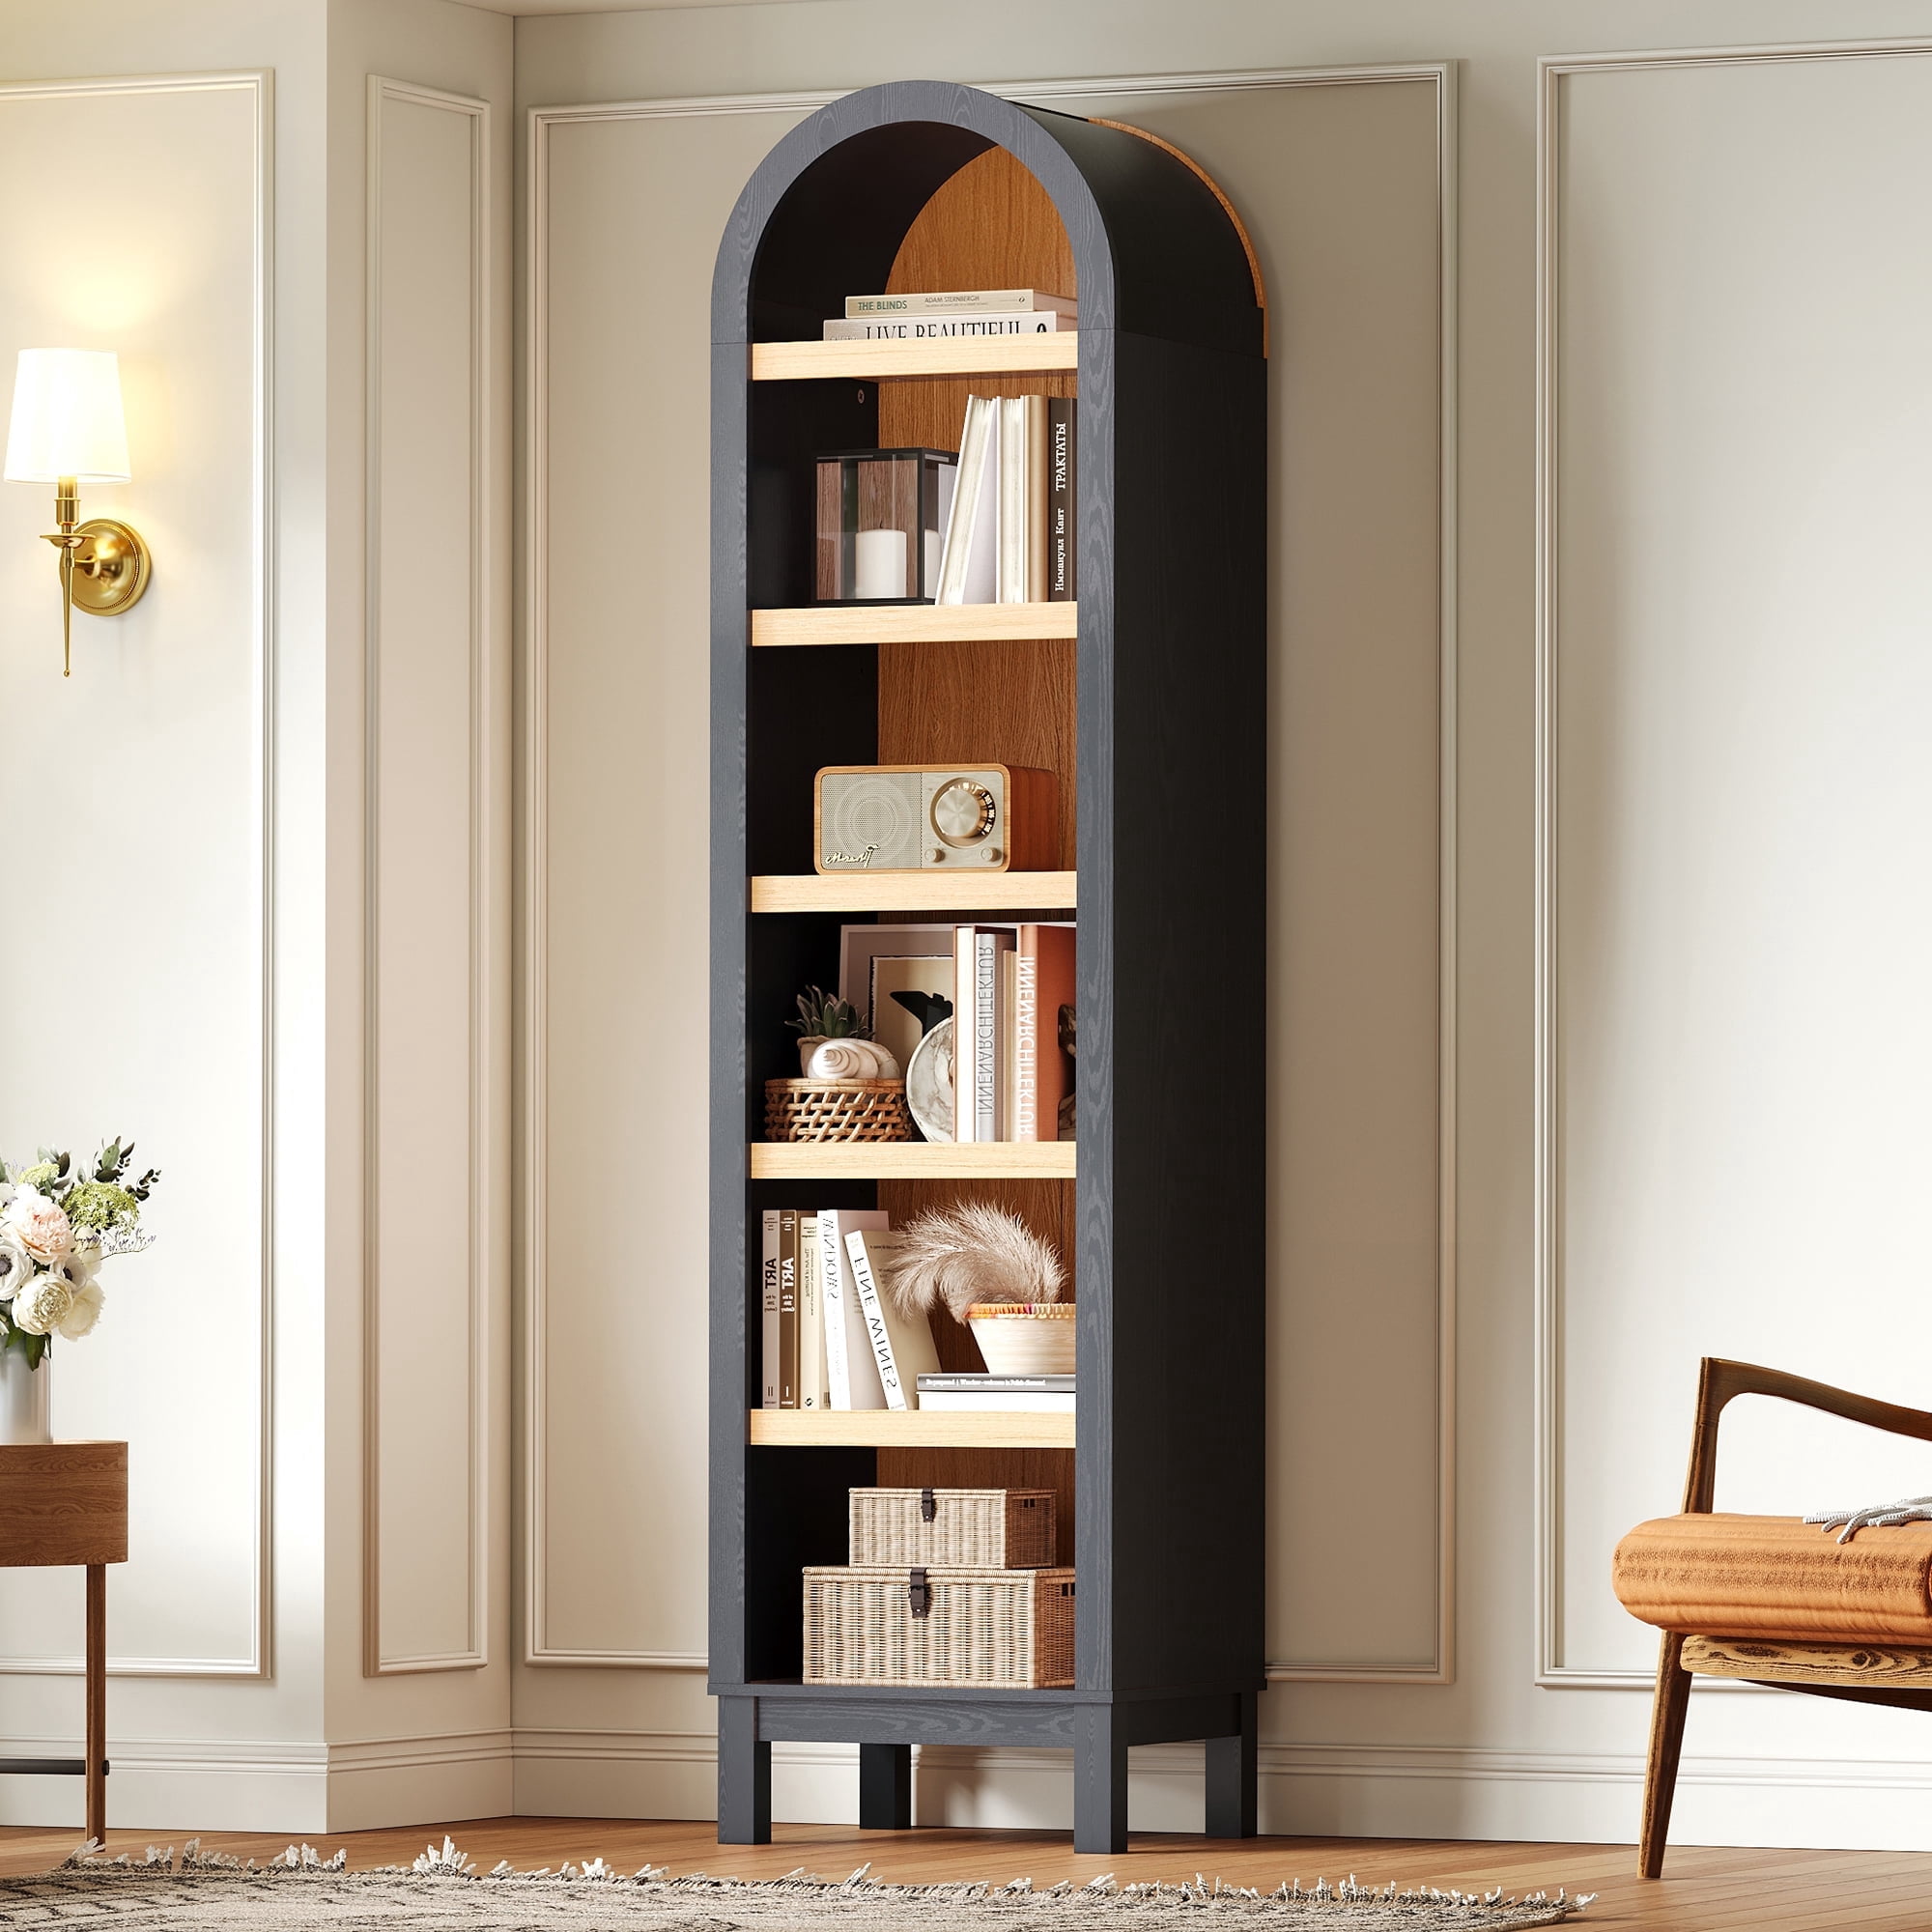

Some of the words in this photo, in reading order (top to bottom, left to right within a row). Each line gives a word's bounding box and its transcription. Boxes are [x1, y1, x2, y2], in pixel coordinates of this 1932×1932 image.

[858, 301, 874, 311] THE
[876, 300, 908, 310] BLINDS
[1056, 423, 1066, 492] ТРАКТАТЫ
[1055, 508, 1065, 534] Кант
